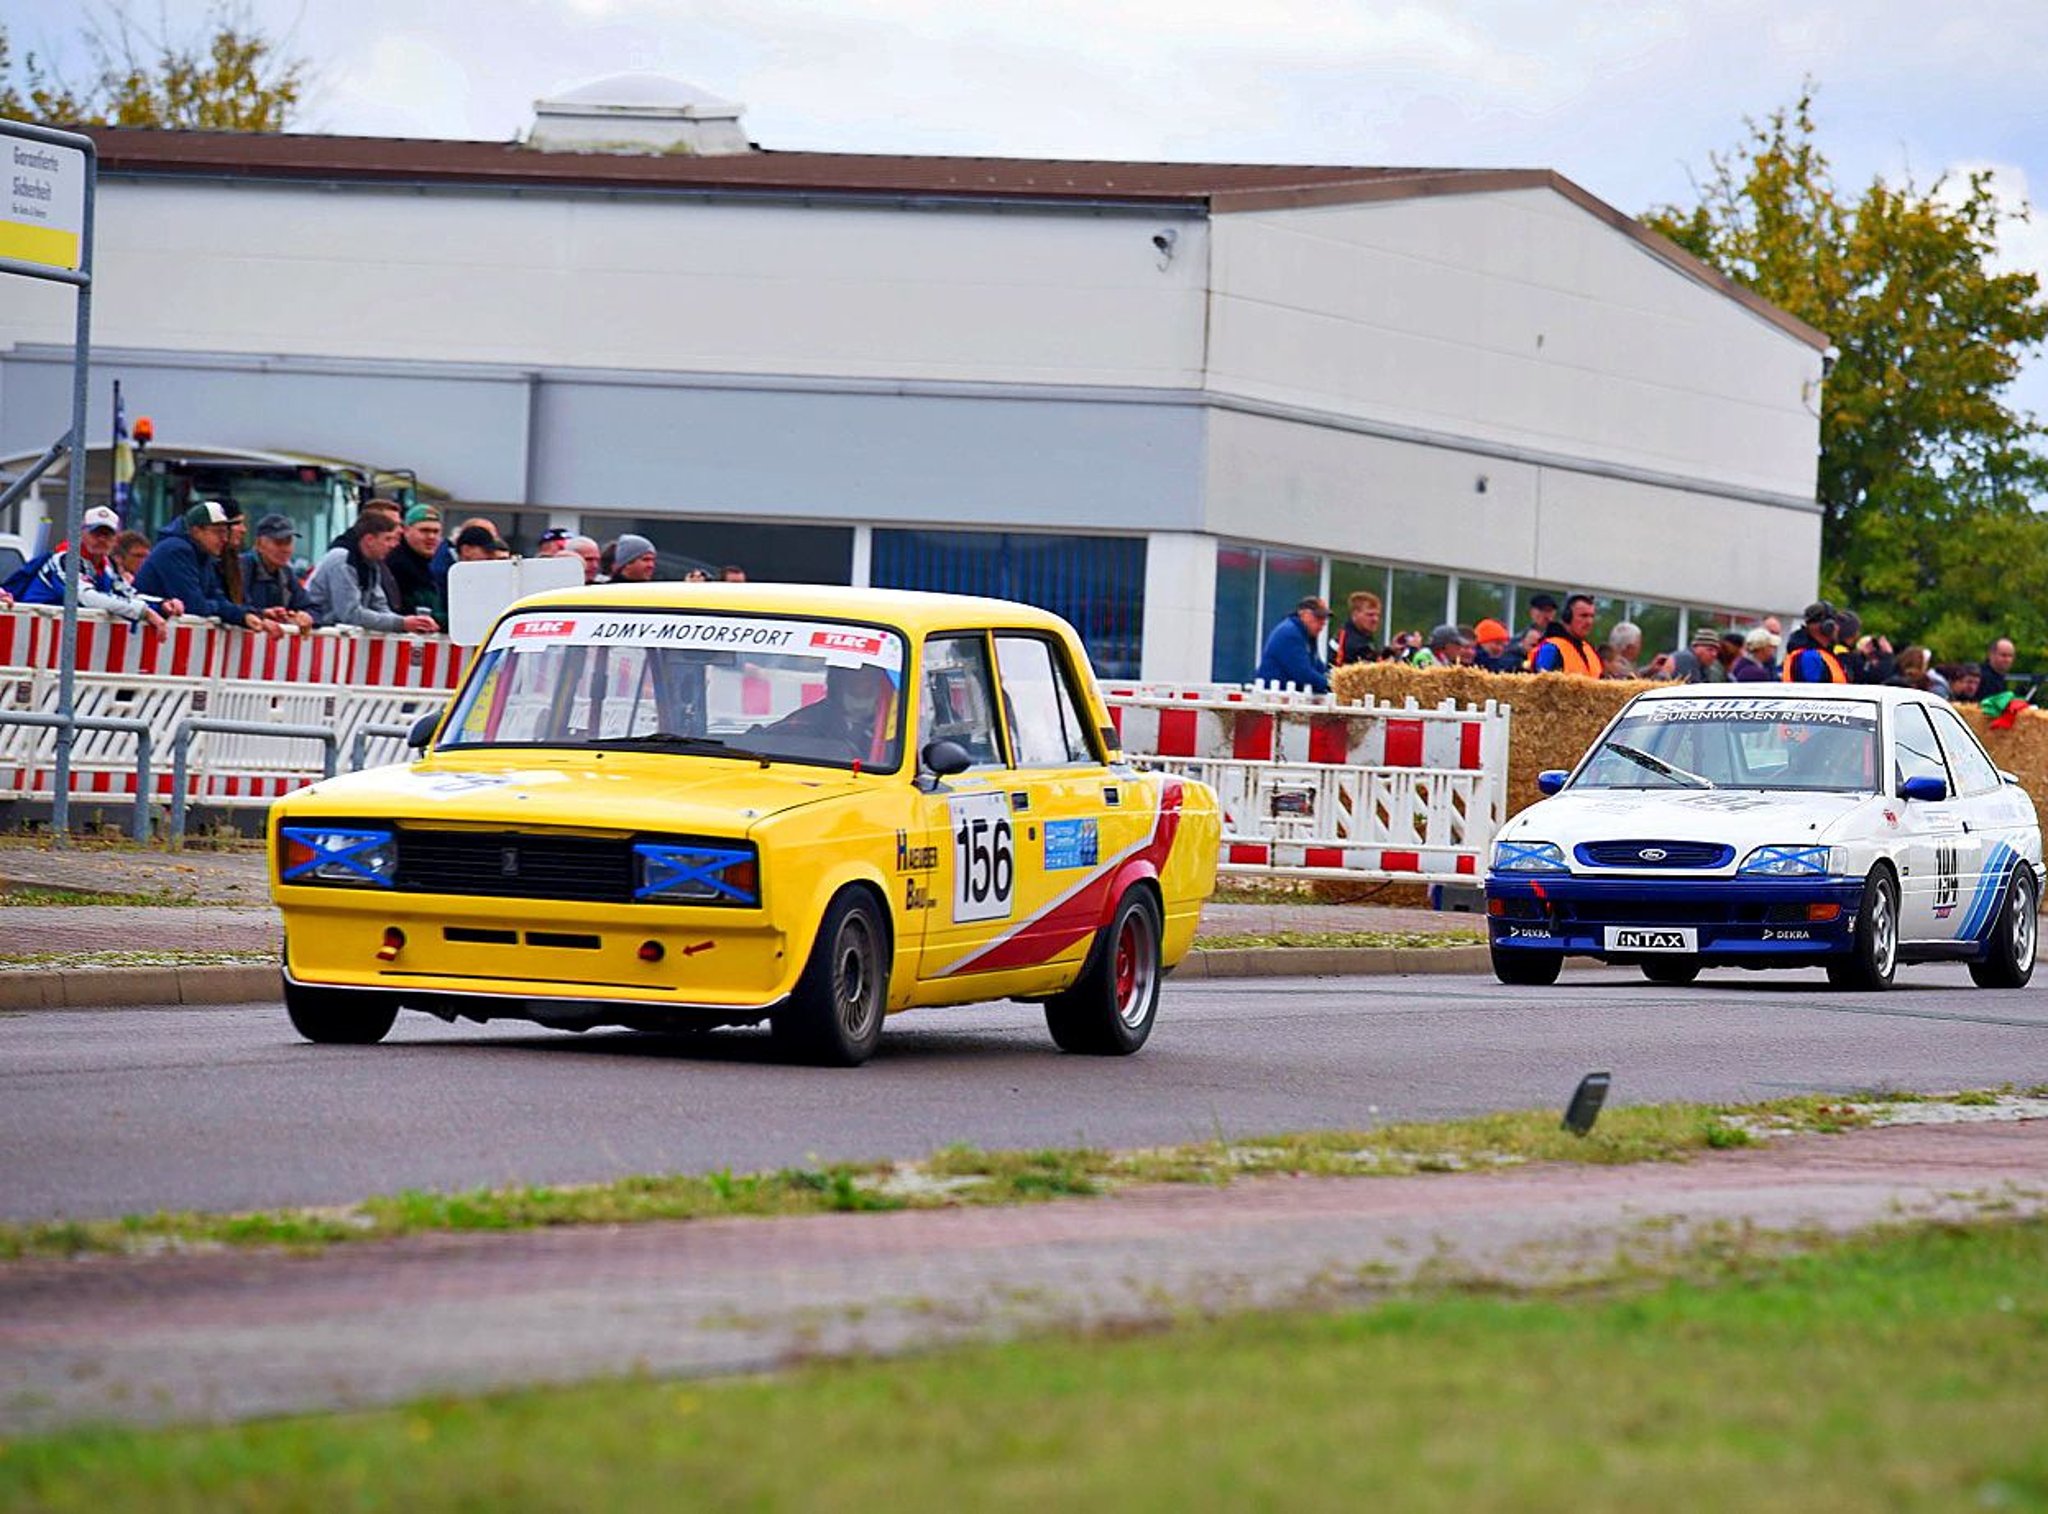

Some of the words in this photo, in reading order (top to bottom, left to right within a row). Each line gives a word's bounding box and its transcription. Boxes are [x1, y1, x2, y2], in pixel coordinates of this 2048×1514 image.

[591, 623, 794, 646] ADMV-MOTORSPORT
[1647, 710, 1777, 722] TOURENWAGEN
[1781, 712, 1850, 725] REVIVAL
[957, 818, 1013, 903] 156
[1936, 840, 1959, 904] 194
[1521, 927, 1551, 938] DEKRA
[1620, 933, 1682, 947] INTAX
[1776, 930, 1810, 939] DEKRA
